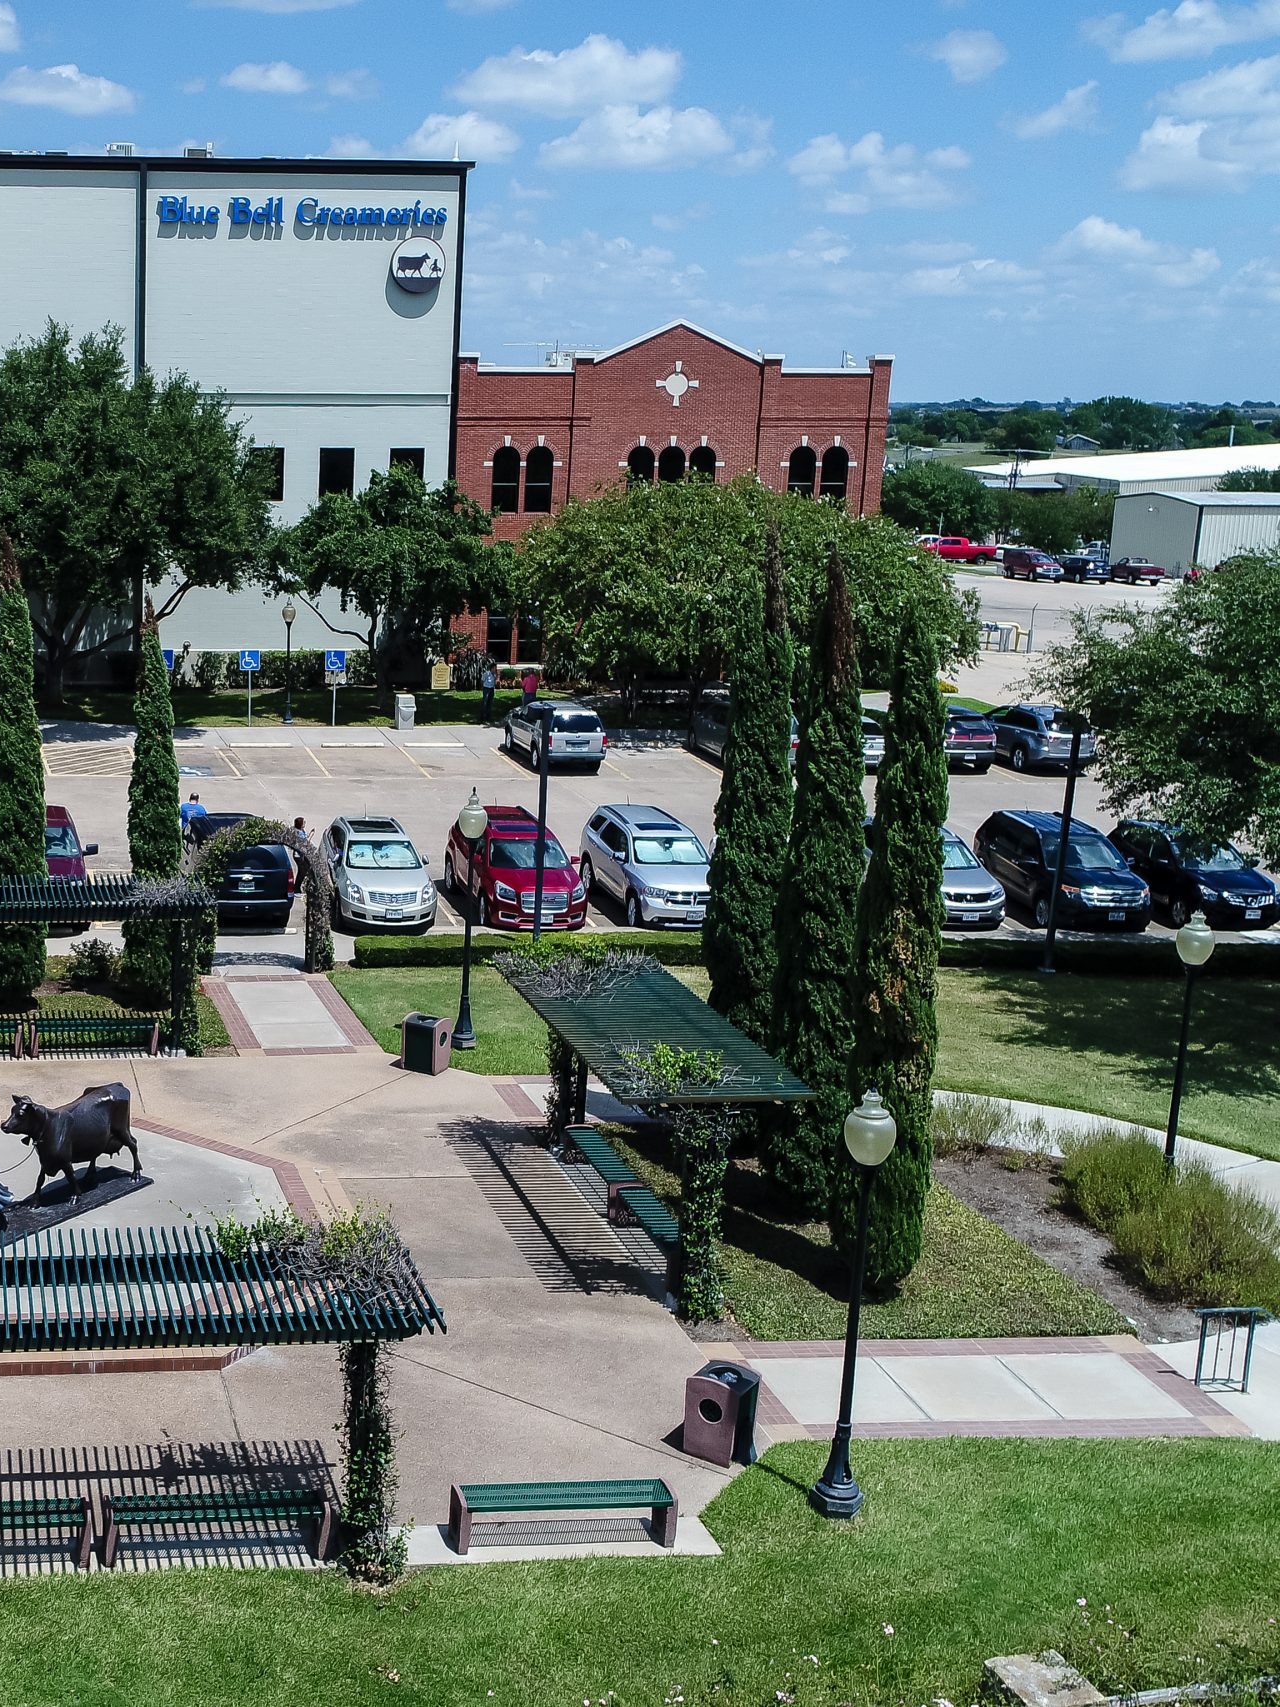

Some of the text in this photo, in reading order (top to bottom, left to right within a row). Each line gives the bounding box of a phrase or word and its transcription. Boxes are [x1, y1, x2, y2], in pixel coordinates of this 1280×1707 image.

[159, 195, 448, 226] Blue Bell Creameries
